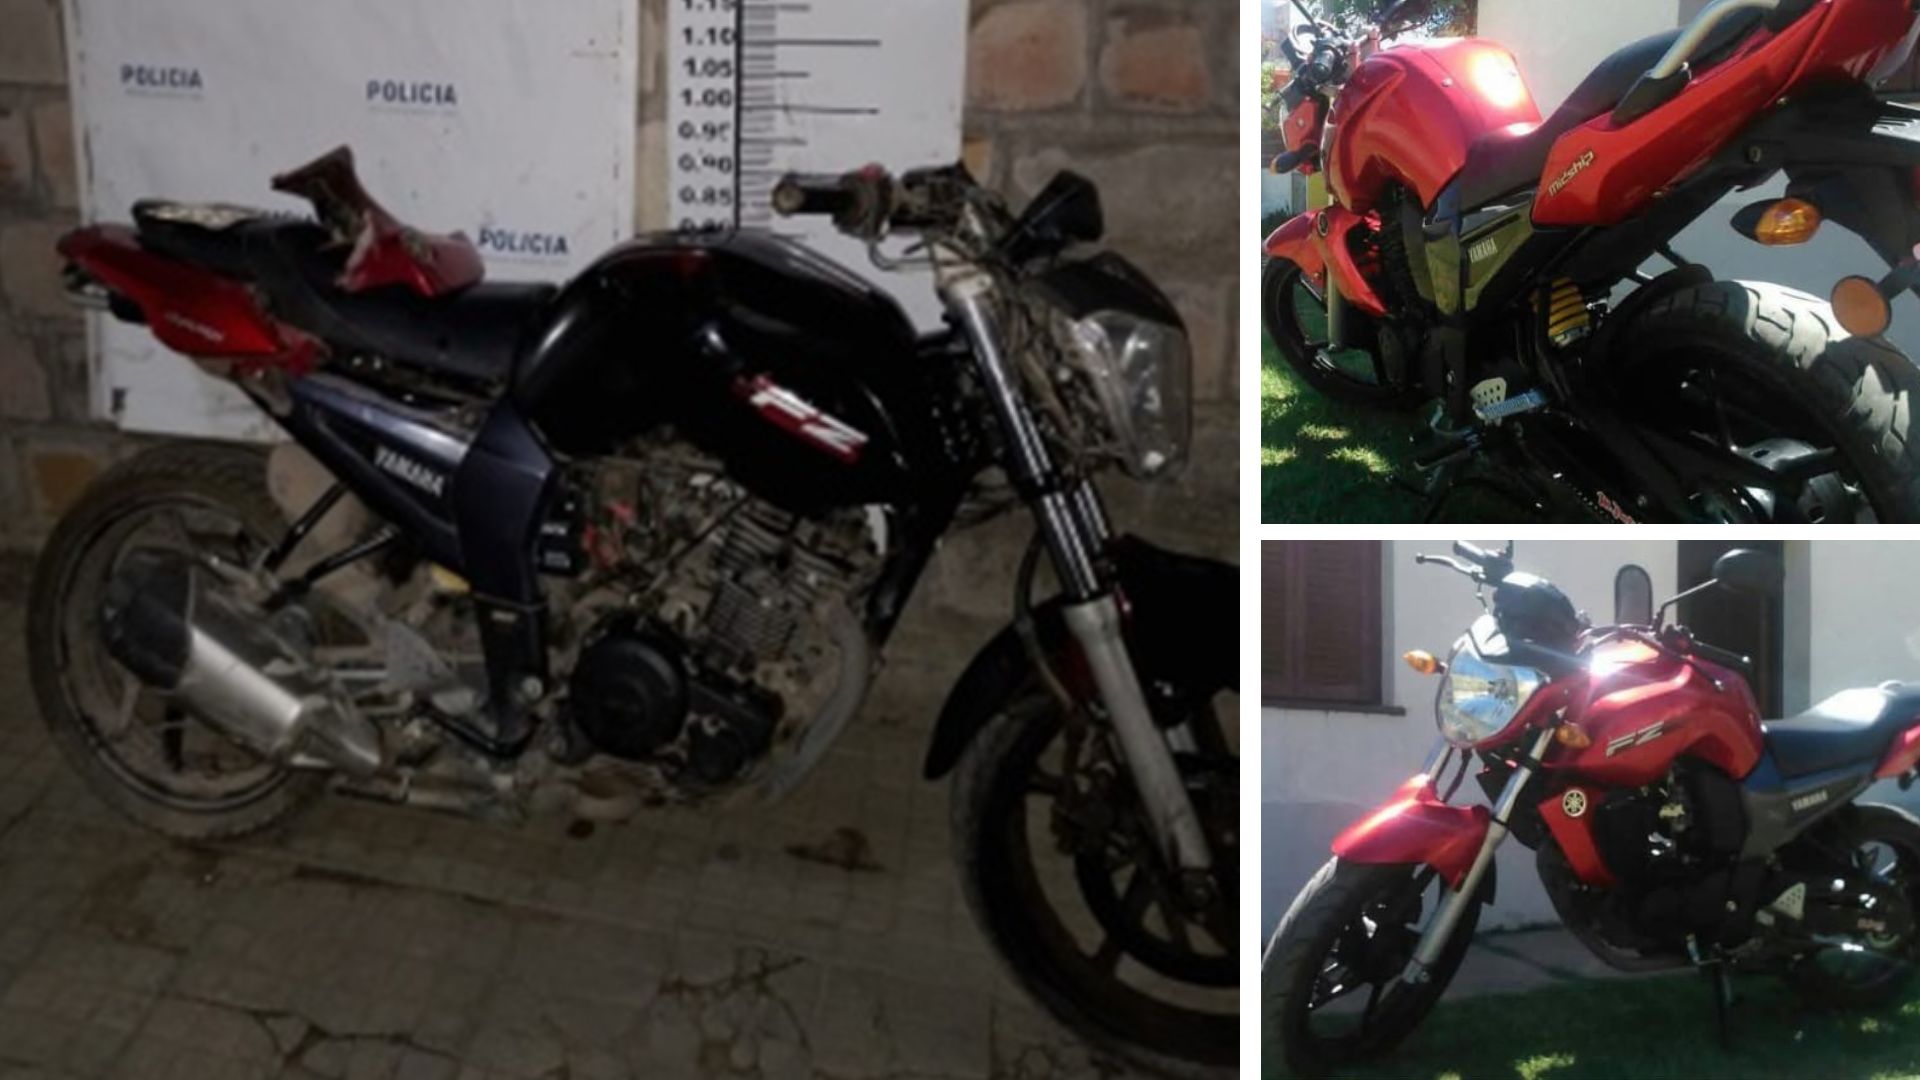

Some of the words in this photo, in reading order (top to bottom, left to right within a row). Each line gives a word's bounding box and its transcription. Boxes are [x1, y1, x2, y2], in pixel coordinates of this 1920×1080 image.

[682, 27, 738, 46] 1.10
[120, 63, 204, 89] POLICIA
[683, 57, 732, 79] 1.05
[367, 80, 457, 106] POLICIA
[680, 88, 731, 108] 1.00
[479, 227, 569, 255] POLICIA
[1468, 237, 1498, 264] YAMAHA
[749, 383, 869, 454] FZ
[374, 446, 444, 498] YAMAHA
[1606, 720, 1665, 757] FZ
